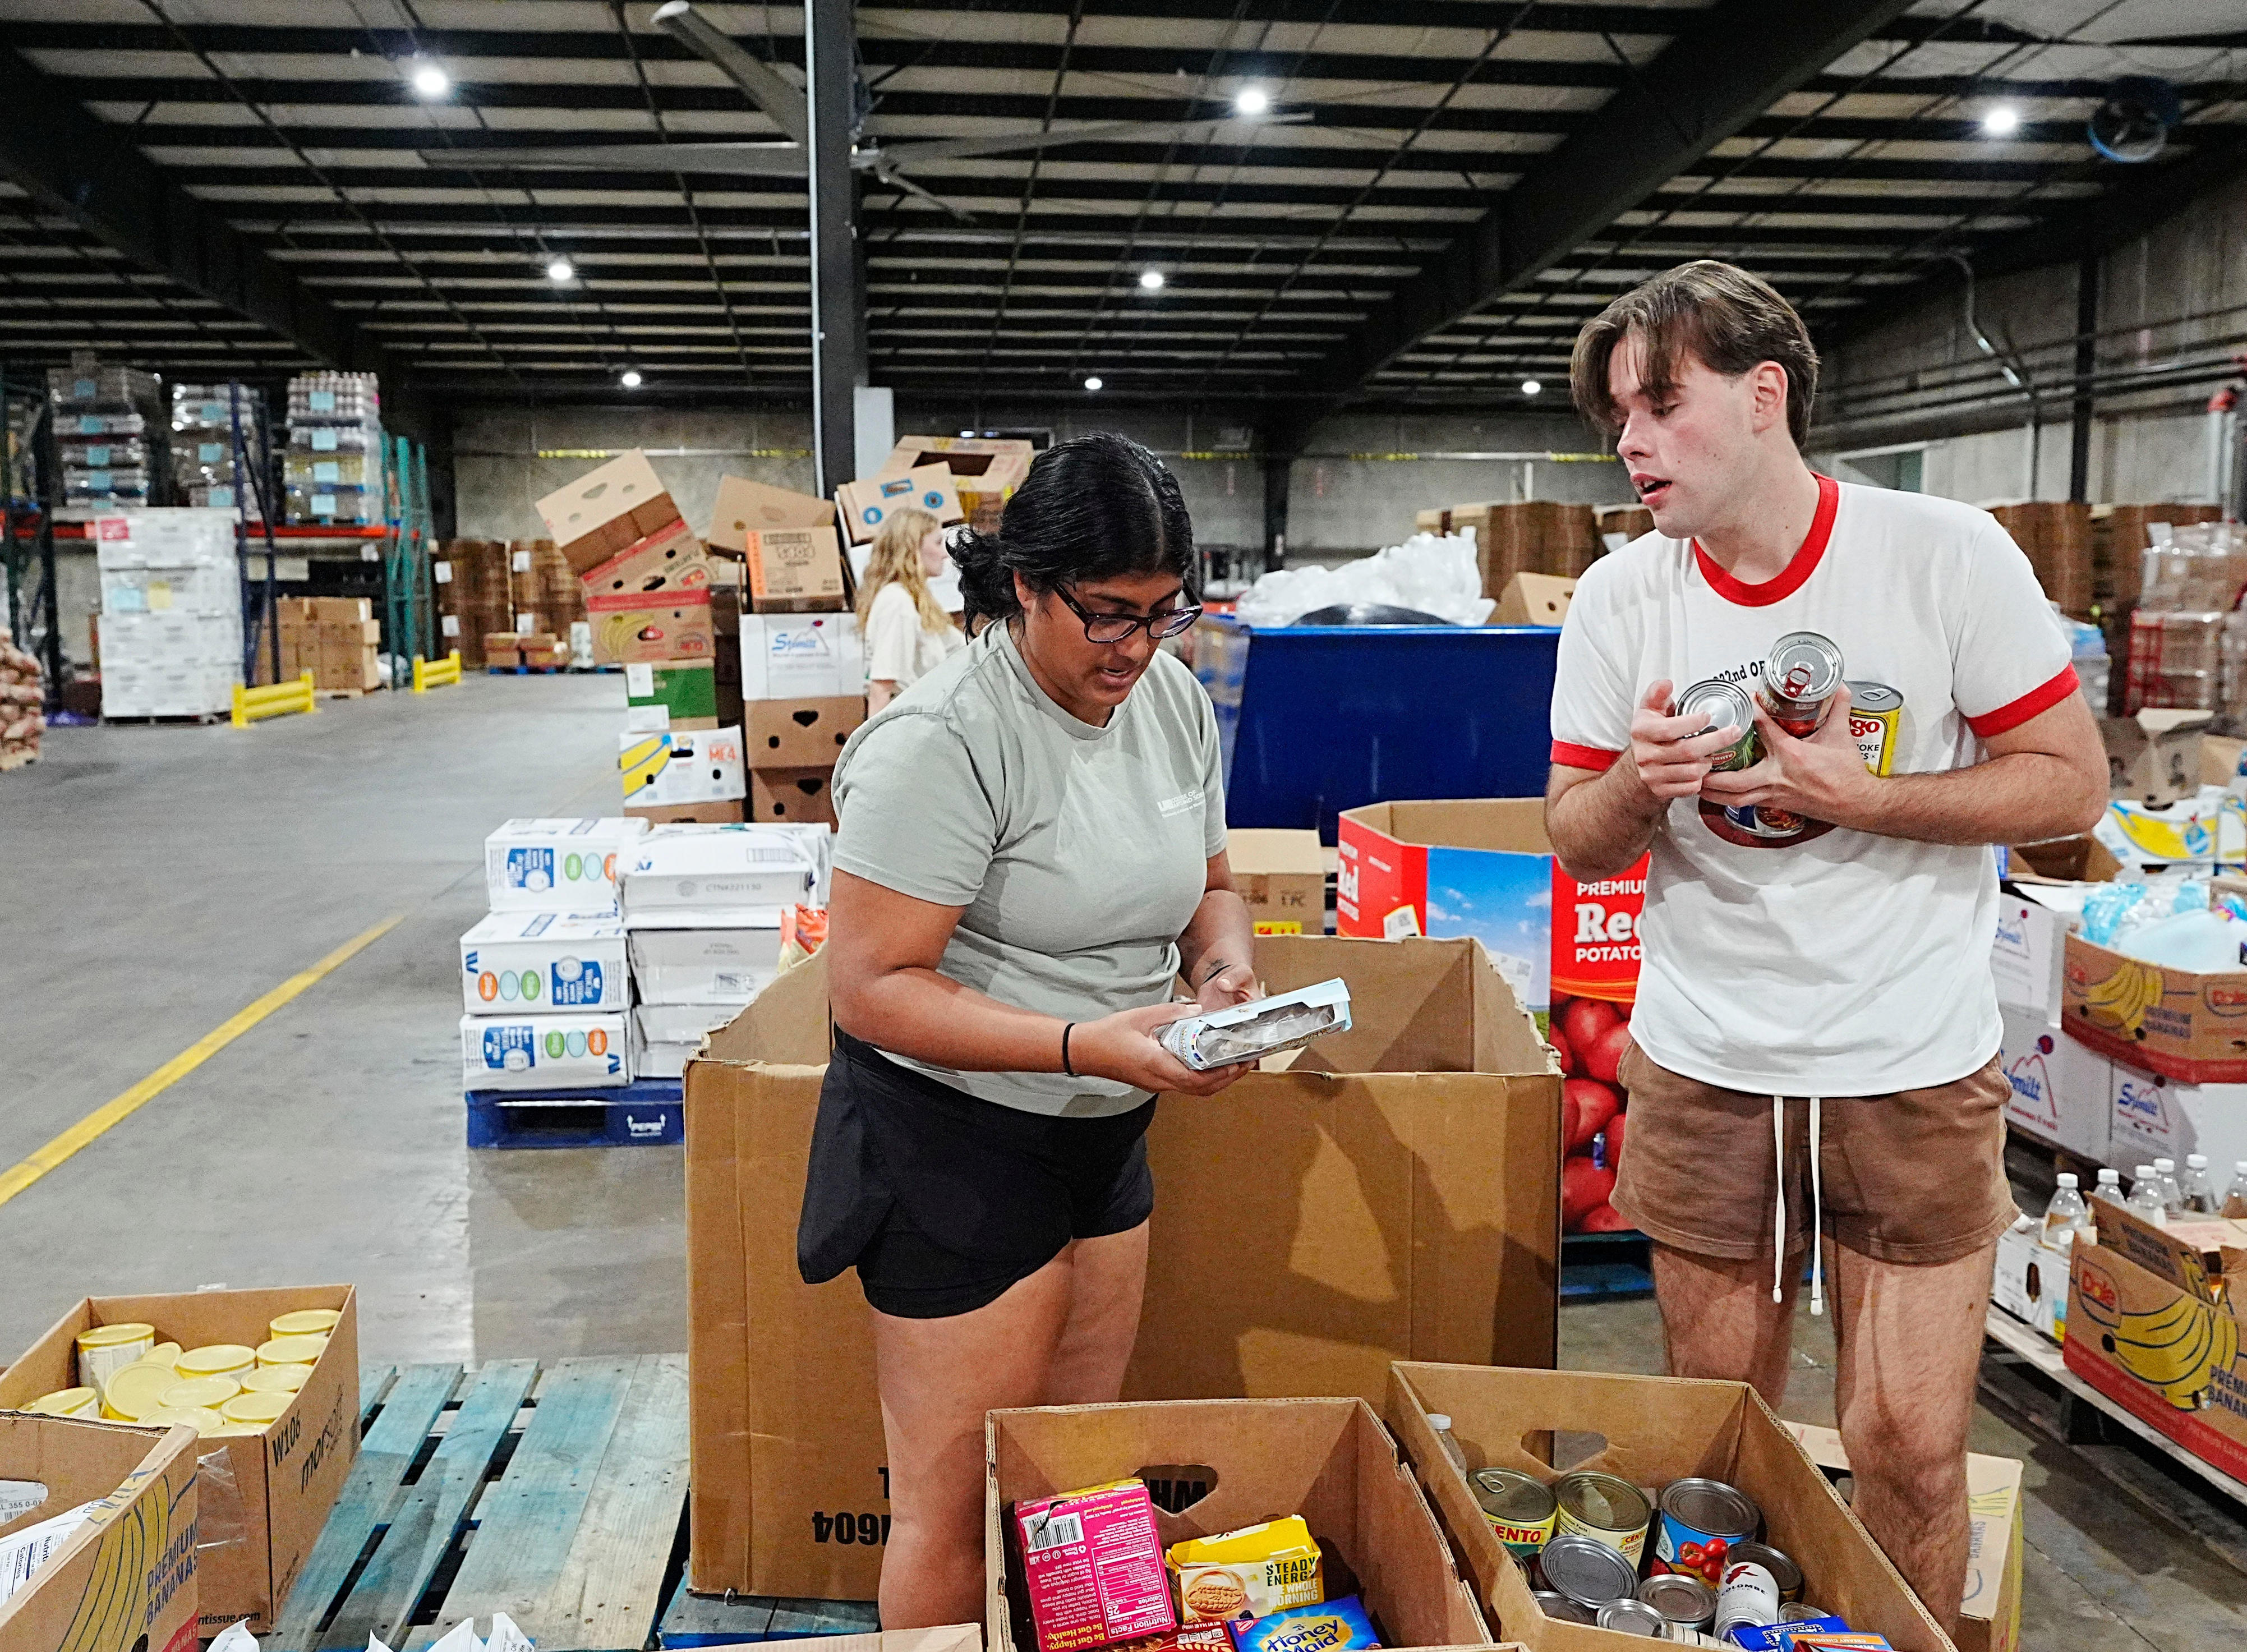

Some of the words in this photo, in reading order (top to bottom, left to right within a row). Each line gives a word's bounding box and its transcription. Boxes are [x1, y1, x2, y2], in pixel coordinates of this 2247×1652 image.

[1849, 717, 1869, 737] go
[1574, 903, 1642, 944] Re
[1576, 945, 1642, 963] POTATO
[272, 1409, 301, 1467] W106
[43, 1535, 52, 1563] Nutriti
[16, 1547, 26, 1580] Calories
[1265, 1556, 1316, 1576] STEADY
[1286, 1579, 1318, 1594] WHOLE
[1138, 1594, 1163, 1604] Calories
[1269, 1589, 1319, 1608] MORNING
[1106, 1604, 1120, 1616] 25
[1077, 1625, 1092, 1635] Gut
[1092, 1622, 1103, 1631] Be
[1110, 1624, 1132, 1635] Facts
[1134, 1616, 1168, 1630] Nutrition
[1044, 1627, 1077, 1642] Healthy.
[1077, 1635, 1093, 1645] Gut
[1093, 1632, 1104, 1641] Be
[1267, 1619, 1338, 1652] Honey
[1046, 1637, 1076, 1652] Happy.
